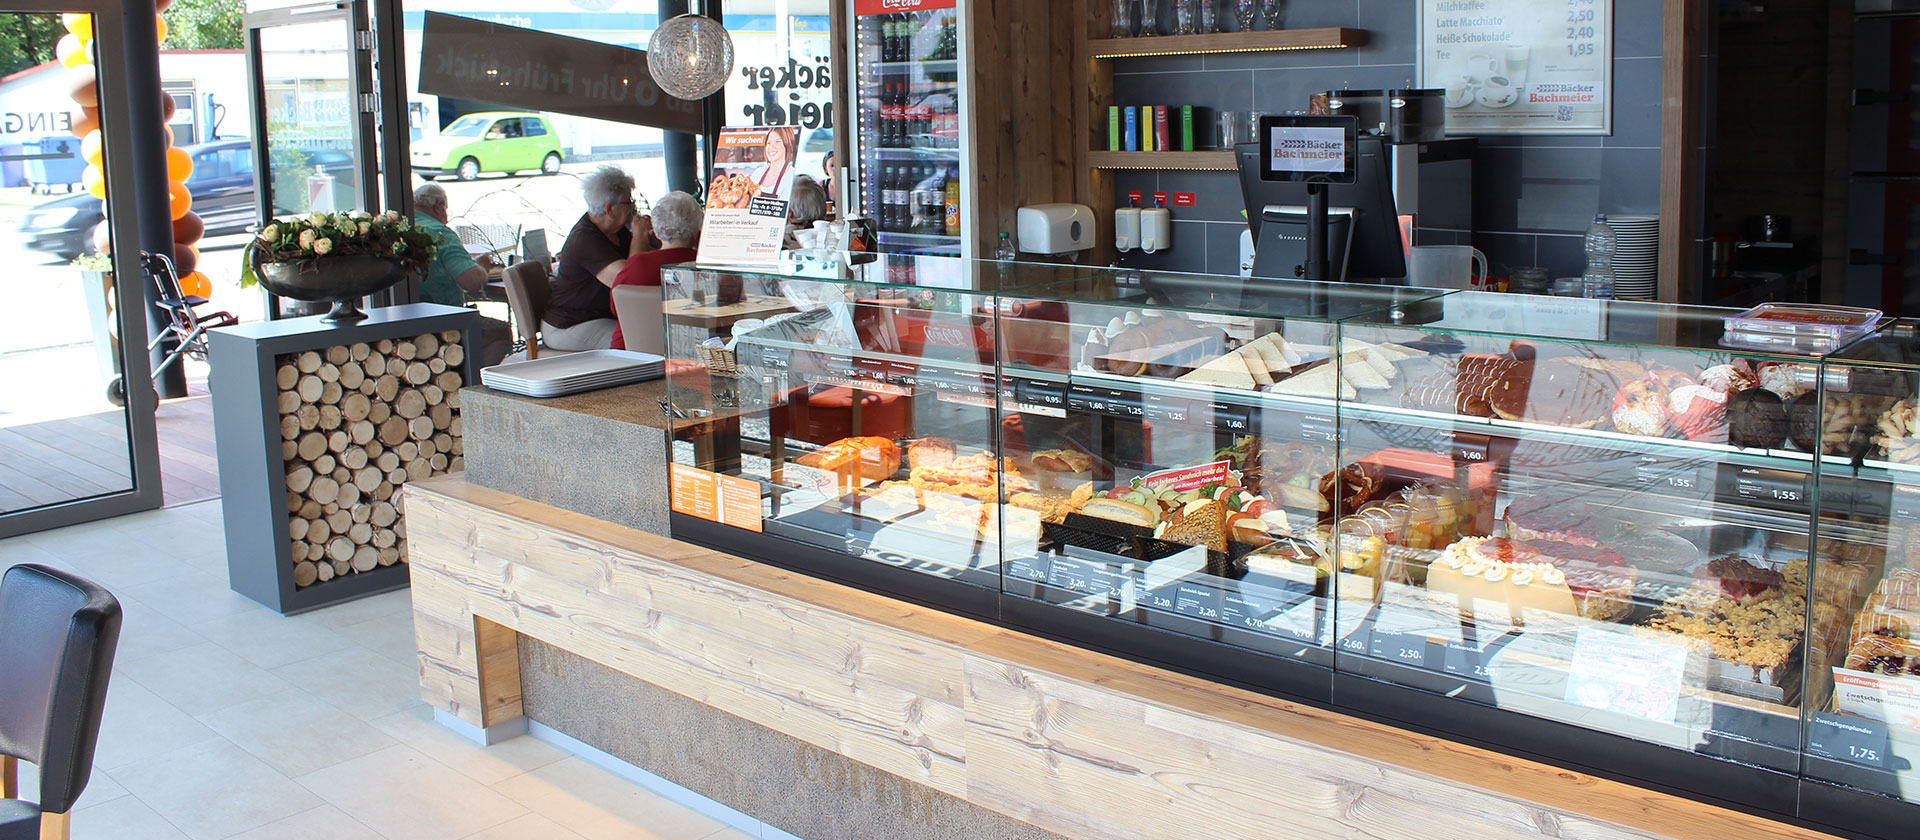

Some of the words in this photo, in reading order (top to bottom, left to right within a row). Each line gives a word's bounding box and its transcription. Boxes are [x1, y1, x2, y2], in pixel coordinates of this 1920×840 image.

[1436, 2, 1485, 12] Milchkaffee
[1436, 18, 1458, 28] Latte
[1459, 17, 1503, 27] Macchiato
[1567, 9, 1594, 23] 2,50
[1436, 34, 1461, 44] Heiße
[1462, 32, 1511, 43] Schokolade
[1567, 26, 1594, 40] 2,40
[1436, 50, 1451, 60] Tee
[1567, 44, 1594, 57] 1,95
[1560, 84, 1594, 93] Bäcker
[1529, 93, 1594, 103] Bachmeier
[1307, 140, 1343, 149] Bäcker
[1273, 148, 1343, 159] Bachmeier
[1815, 716, 1873, 735] Zwetschgenplunder
